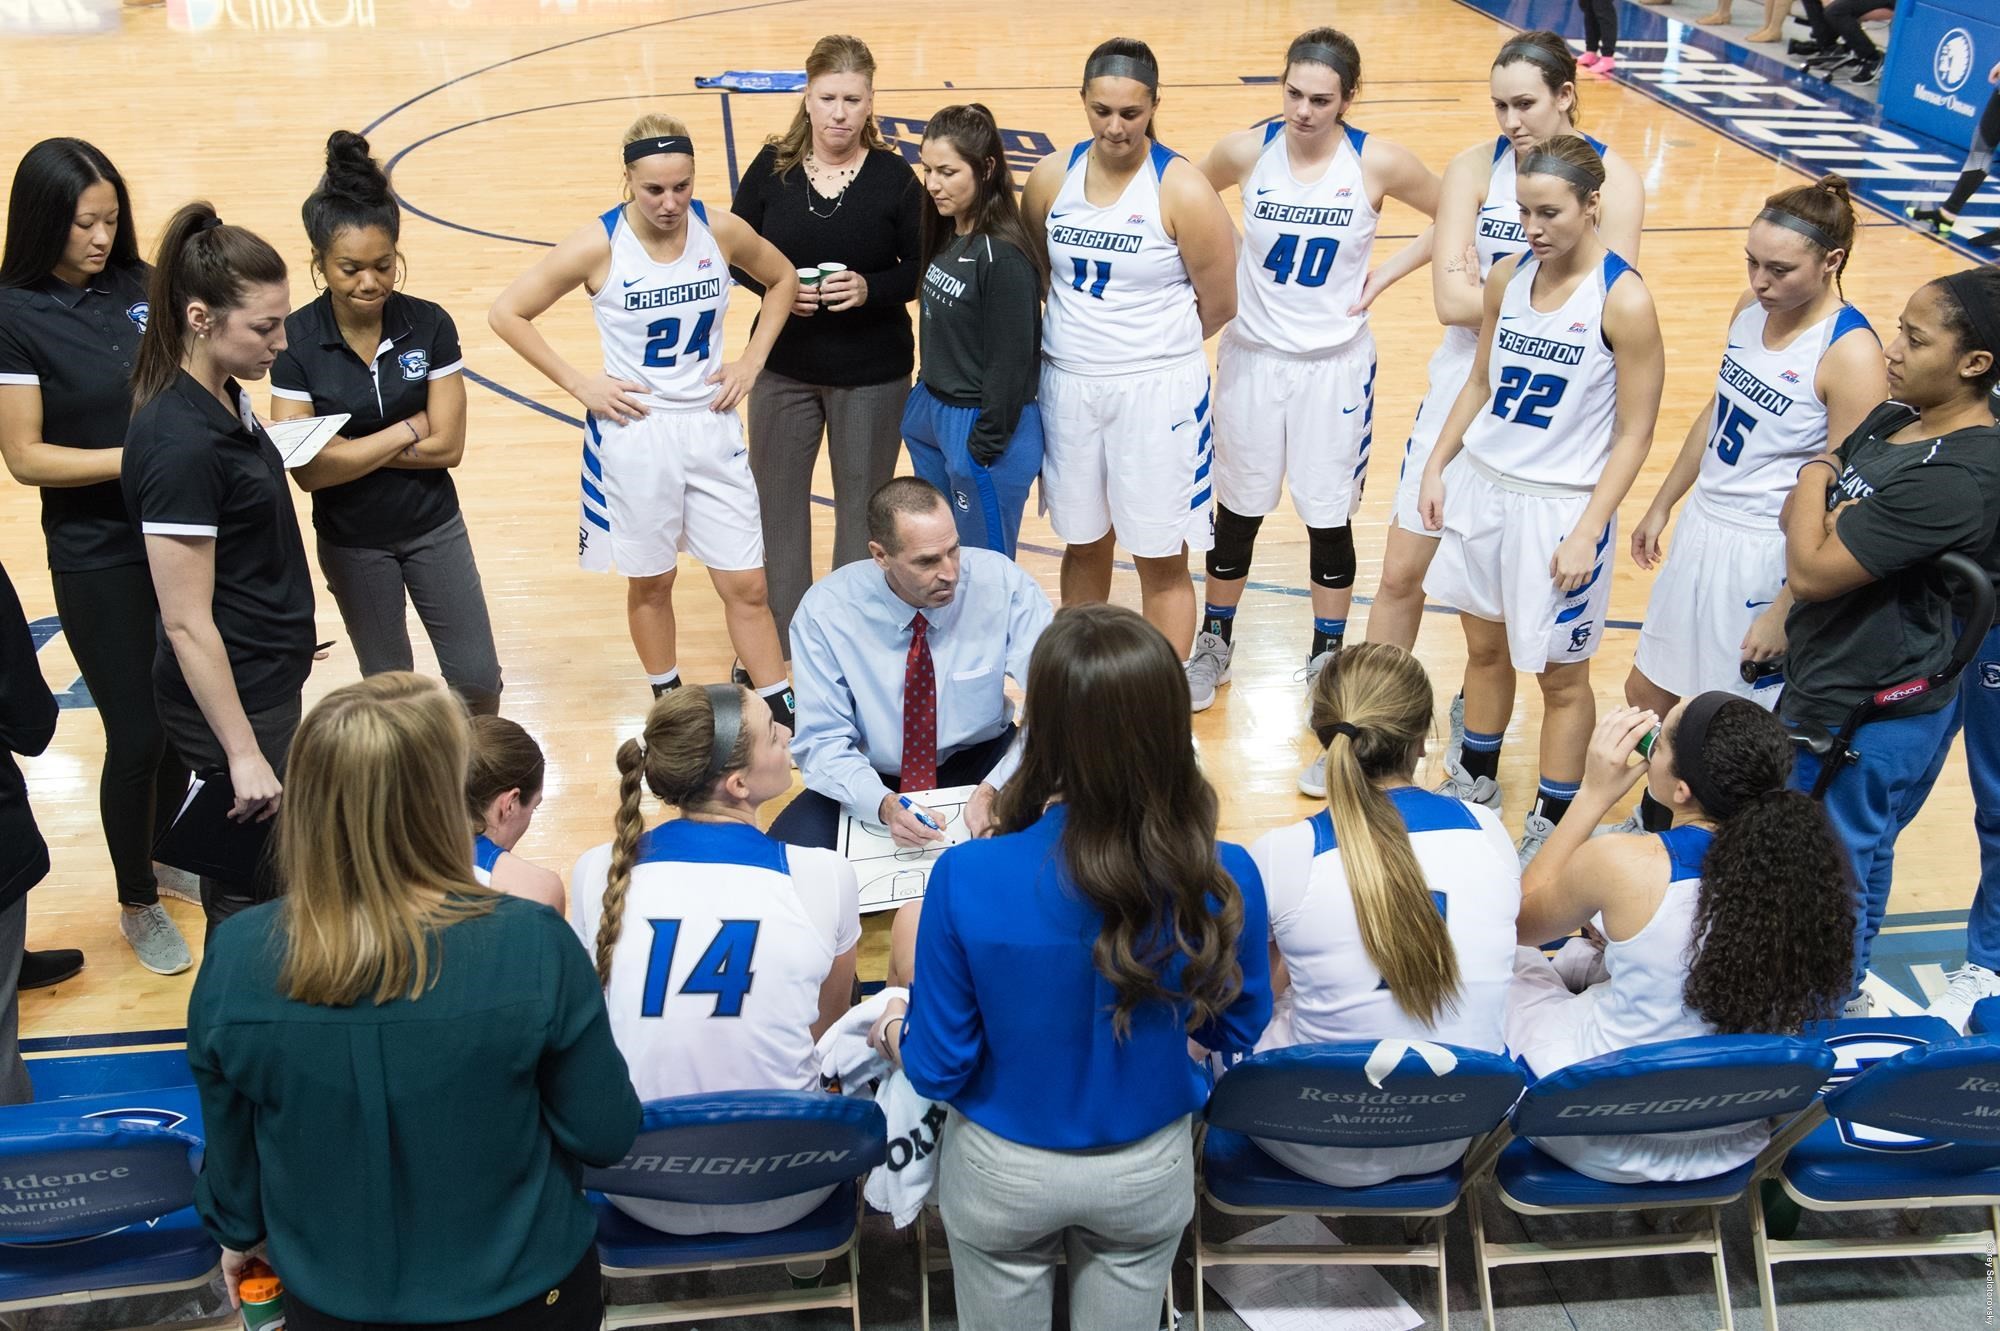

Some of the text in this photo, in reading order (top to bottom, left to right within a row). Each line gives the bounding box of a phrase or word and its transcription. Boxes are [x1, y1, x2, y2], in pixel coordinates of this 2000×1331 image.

[1254, 201, 1353, 226] CREIGHTON
[1052, 225, 1143, 253] CREIGHTON
[1263, 233, 1341, 287] 40
[624, 278, 720, 311] CREIGHTON
[1069, 256, 1112, 300] 11
[641, 309, 717, 367] 24
[1490, 366, 1569, 430] 22
[1708, 391, 1759, 467] 15
[640, 918, 762, 1019] 14
[1297, 1087, 1467, 1105] Residence
[1557, 1085, 1801, 1118] CREIGHTON
[1322, 1114, 1414, 1124] Marriott
[0, 1167, 130, 1190] idence
